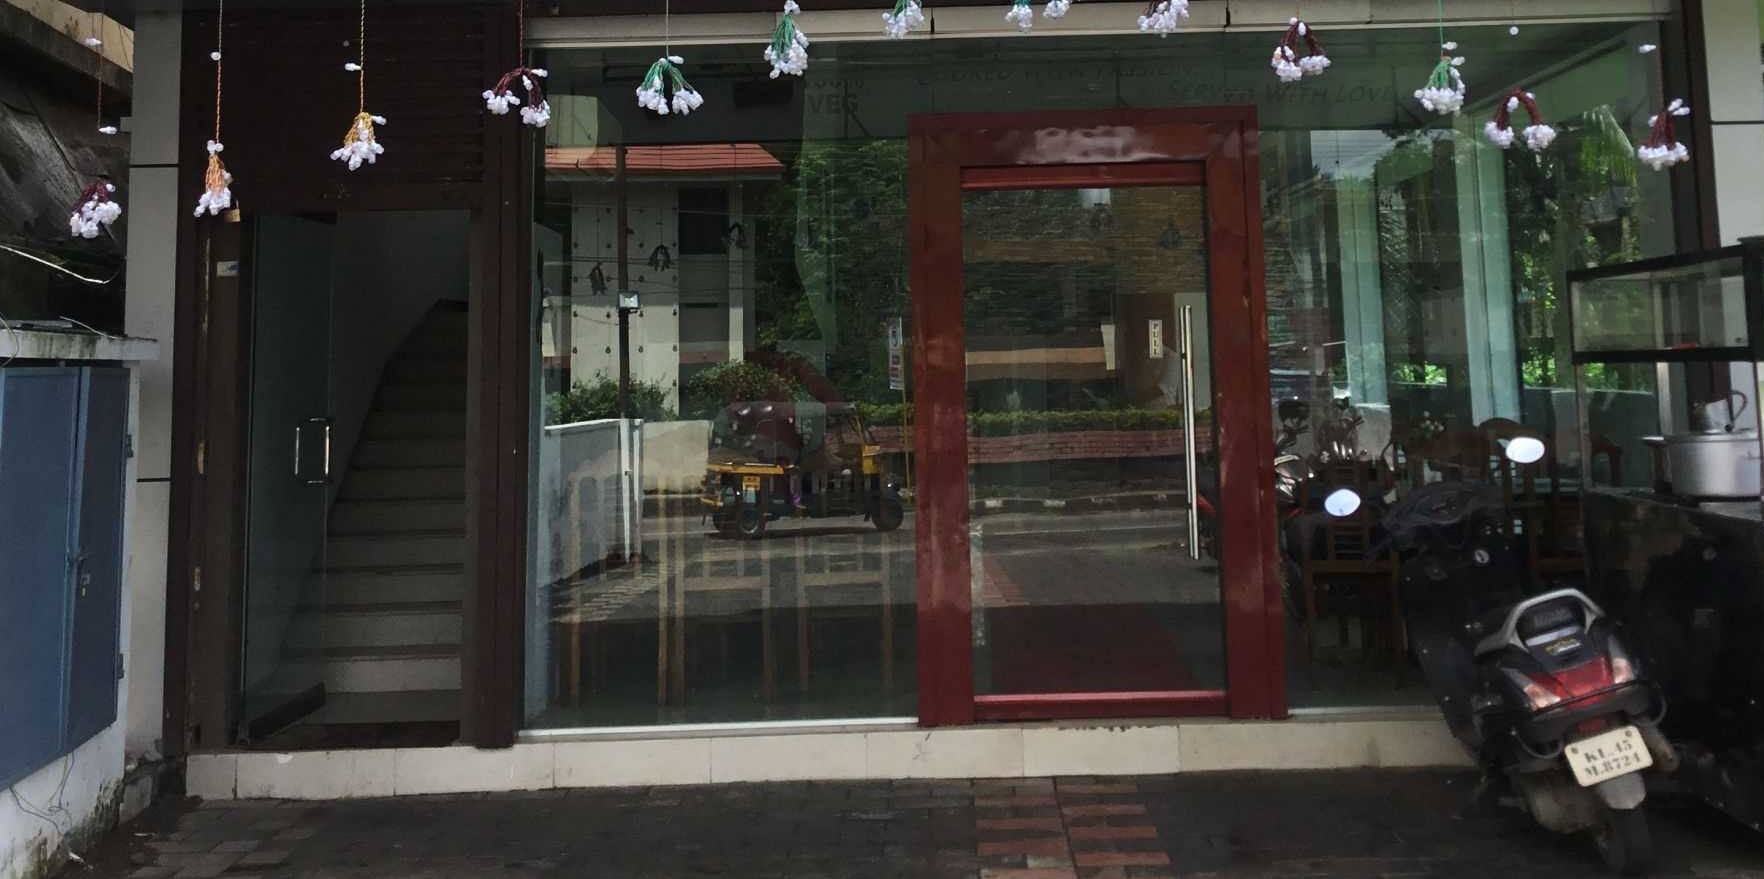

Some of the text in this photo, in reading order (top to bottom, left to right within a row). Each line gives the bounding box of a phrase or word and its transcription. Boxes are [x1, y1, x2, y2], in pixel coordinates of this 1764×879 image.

[1265, 83, 1328, 102] WITH
[808, 94, 860, 113] VEG
[1152, 322, 1160, 356] PULL
